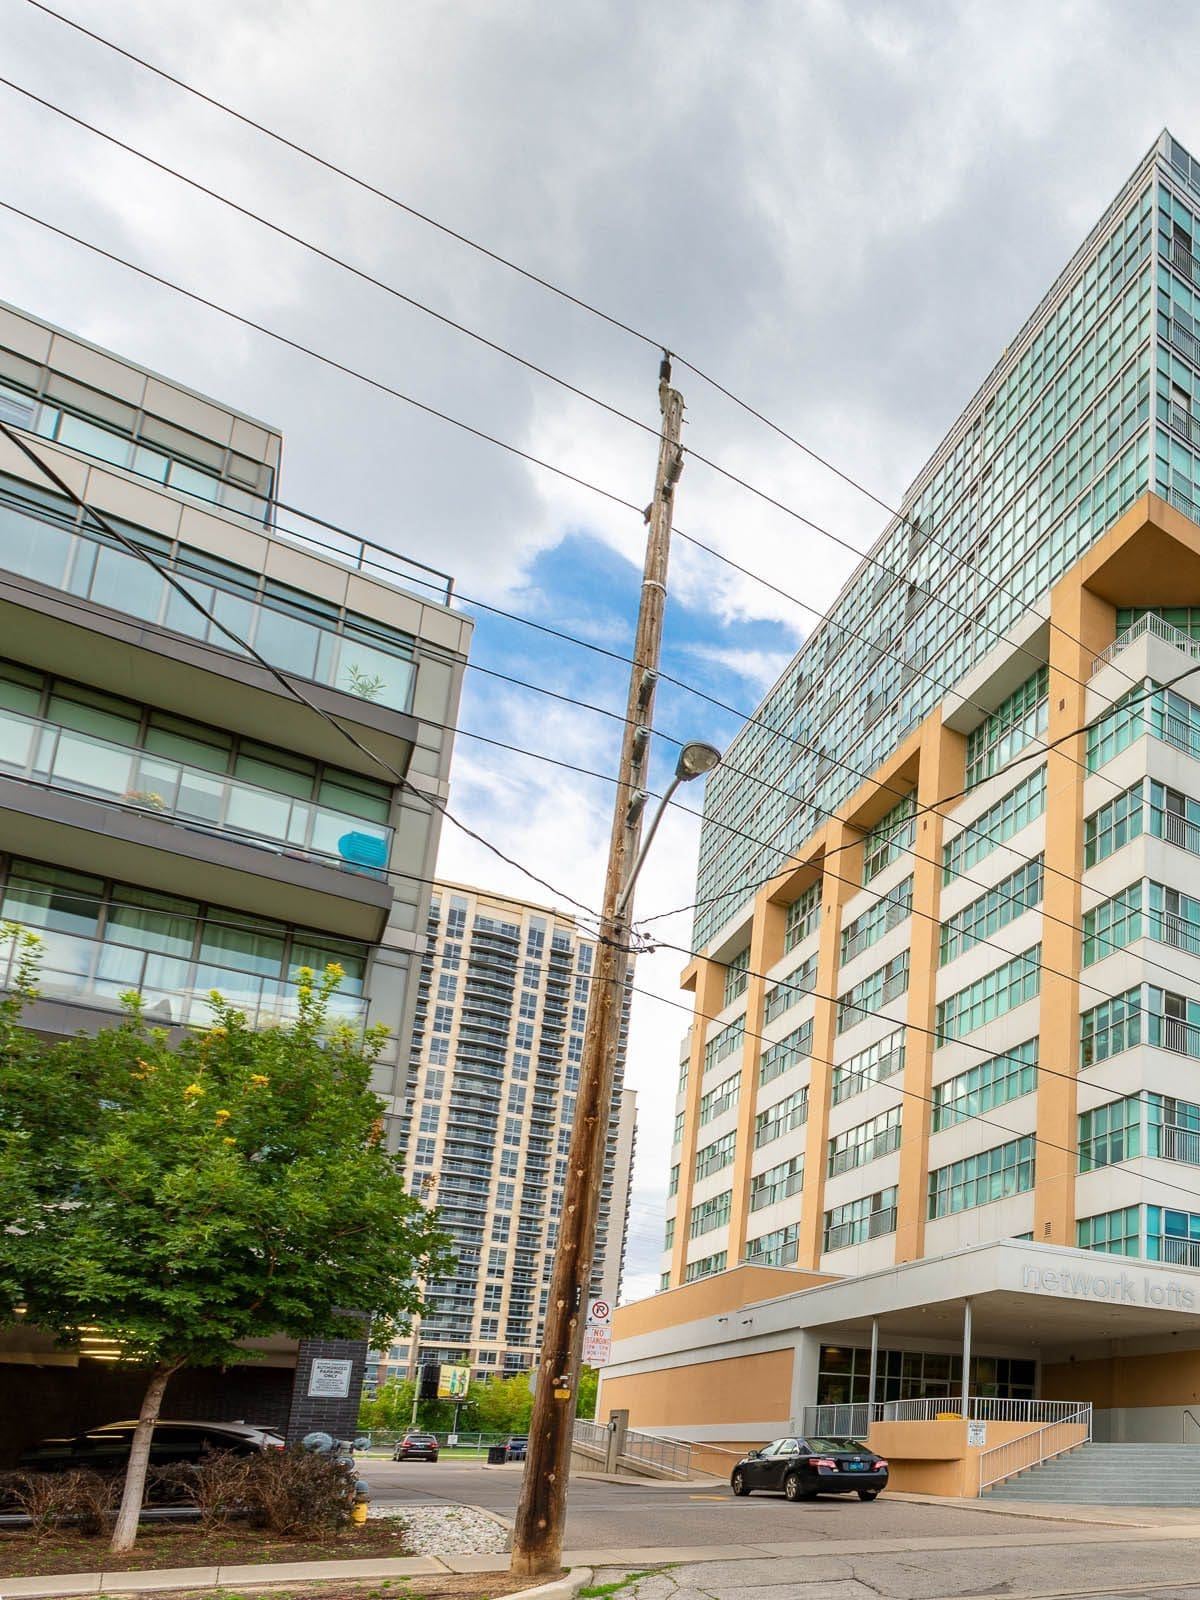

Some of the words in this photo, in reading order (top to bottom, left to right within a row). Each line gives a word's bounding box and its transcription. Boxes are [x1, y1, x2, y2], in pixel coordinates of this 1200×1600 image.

[1022, 1263, 1136, 1302] network
[1143, 1276, 1195, 1308] lofts
[593, 1329, 604, 1337] NO
